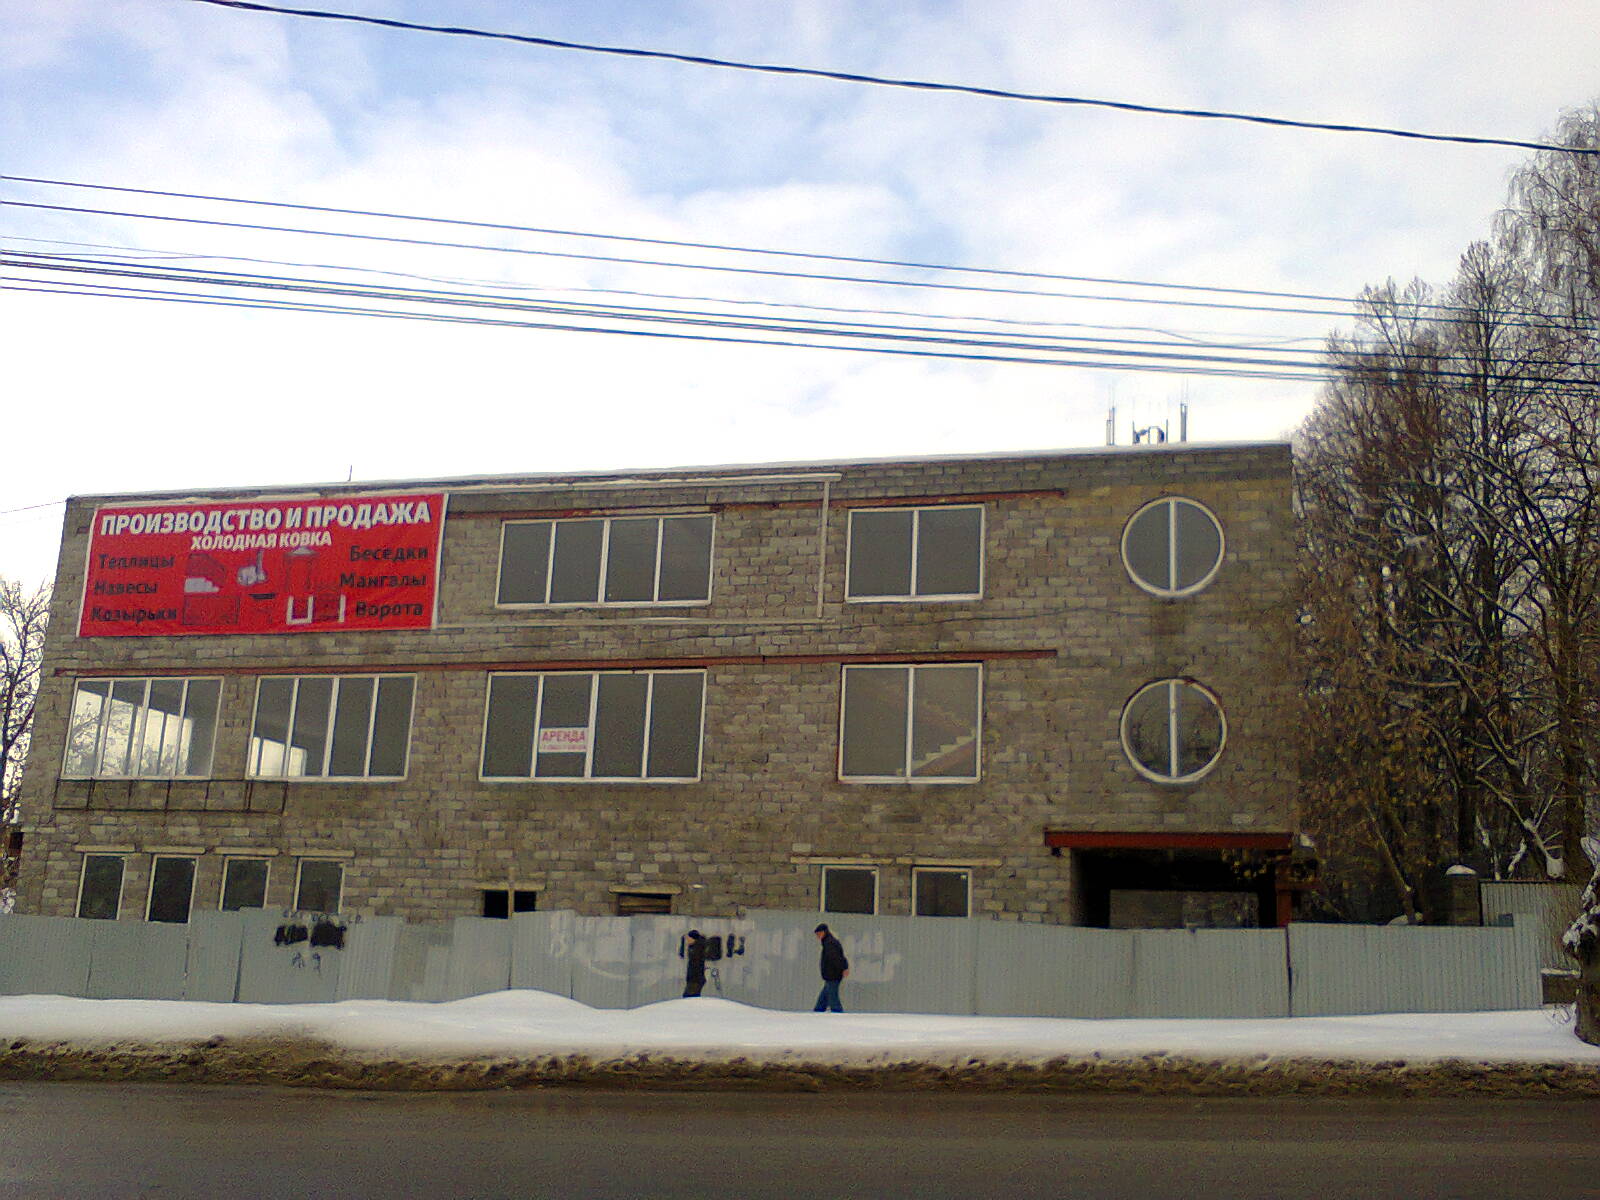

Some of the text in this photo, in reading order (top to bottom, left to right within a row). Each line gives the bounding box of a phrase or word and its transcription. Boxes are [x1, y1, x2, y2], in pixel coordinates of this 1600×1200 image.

[101, 502, 431, 536] ПРОИЗВОДСТВО И ПРОДАЖА
[190, 531, 332, 551] ХОЛОДНАЯ КОВКА
[98, 553, 175, 570] Теплицы
[350, 545, 428, 563] Беседки
[94, 580, 159, 596] Навесы
[340, 572, 427, 589] Мангалы
[91, 606, 178, 625] Козырьки
[356, 601, 424, 621] Ворота
[542, 730, 586, 743] АРЕНДА
